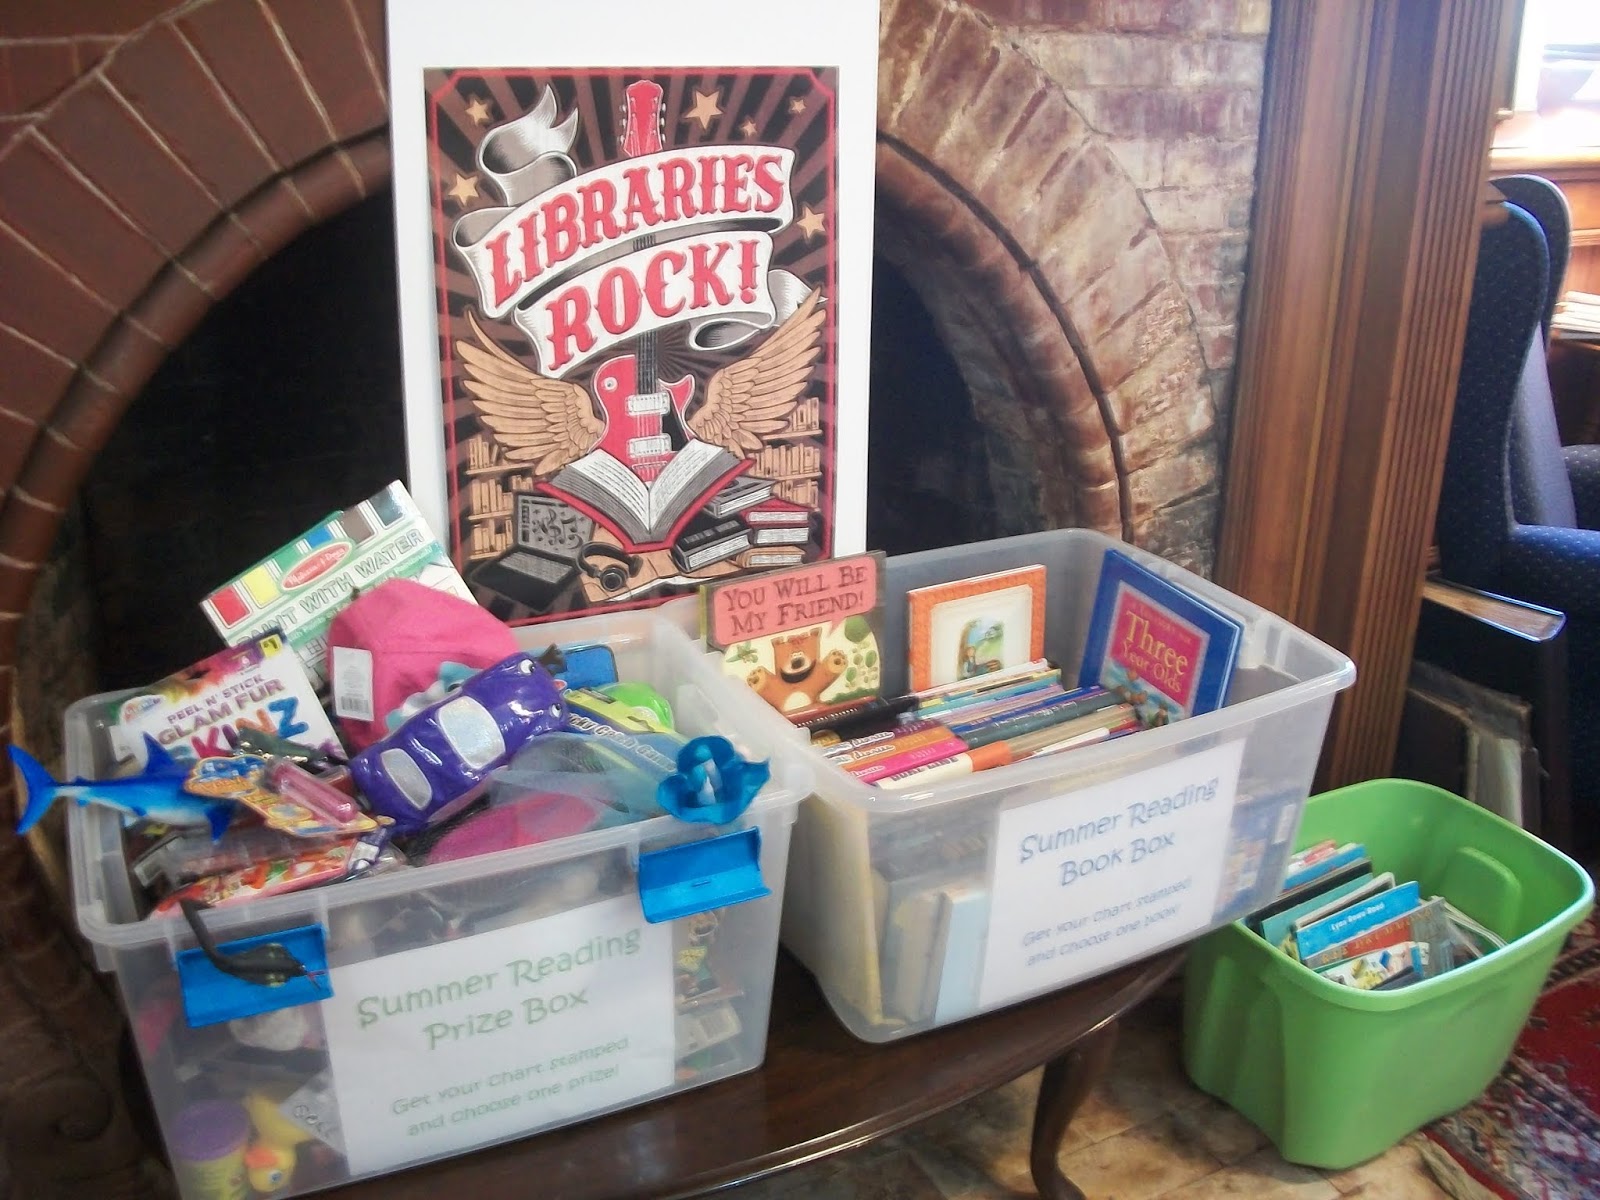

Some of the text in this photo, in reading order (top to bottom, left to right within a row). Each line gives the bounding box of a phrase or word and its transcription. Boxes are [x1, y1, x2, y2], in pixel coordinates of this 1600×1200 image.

[486, 154, 785, 307] LIBRARIES
[545, 240, 759, 371] ROCK!
[300, 574, 354, 614] WITH
[354, 528, 424, 579] WATER
[723, 565, 868, 612] YOU WILL BE
[731, 591, 865, 637] MY FRIEND!
[1126, 611, 1189, 675] Three
[168, 706, 204, 723] PEEL
[224, 674, 265, 700] STICK
[1122, 640, 1182, 693] Year Olds
[157, 704, 232, 745] GLAM
[237, 678, 285, 710] FUR
[1020, 777, 1219, 864] Summer Reading
[1058, 832, 1176, 887] Book Box
[356, 928, 641, 1028] Summer Reading
[422, 988, 590, 1051] Prize Box
[391, 1094, 430, 1116] Get
[438, 1078, 482, 1102] your
[549, 1037, 629, 1071] stamped
[407, 1115, 444, 1137] and
[527, 1078, 561, 1101] one
